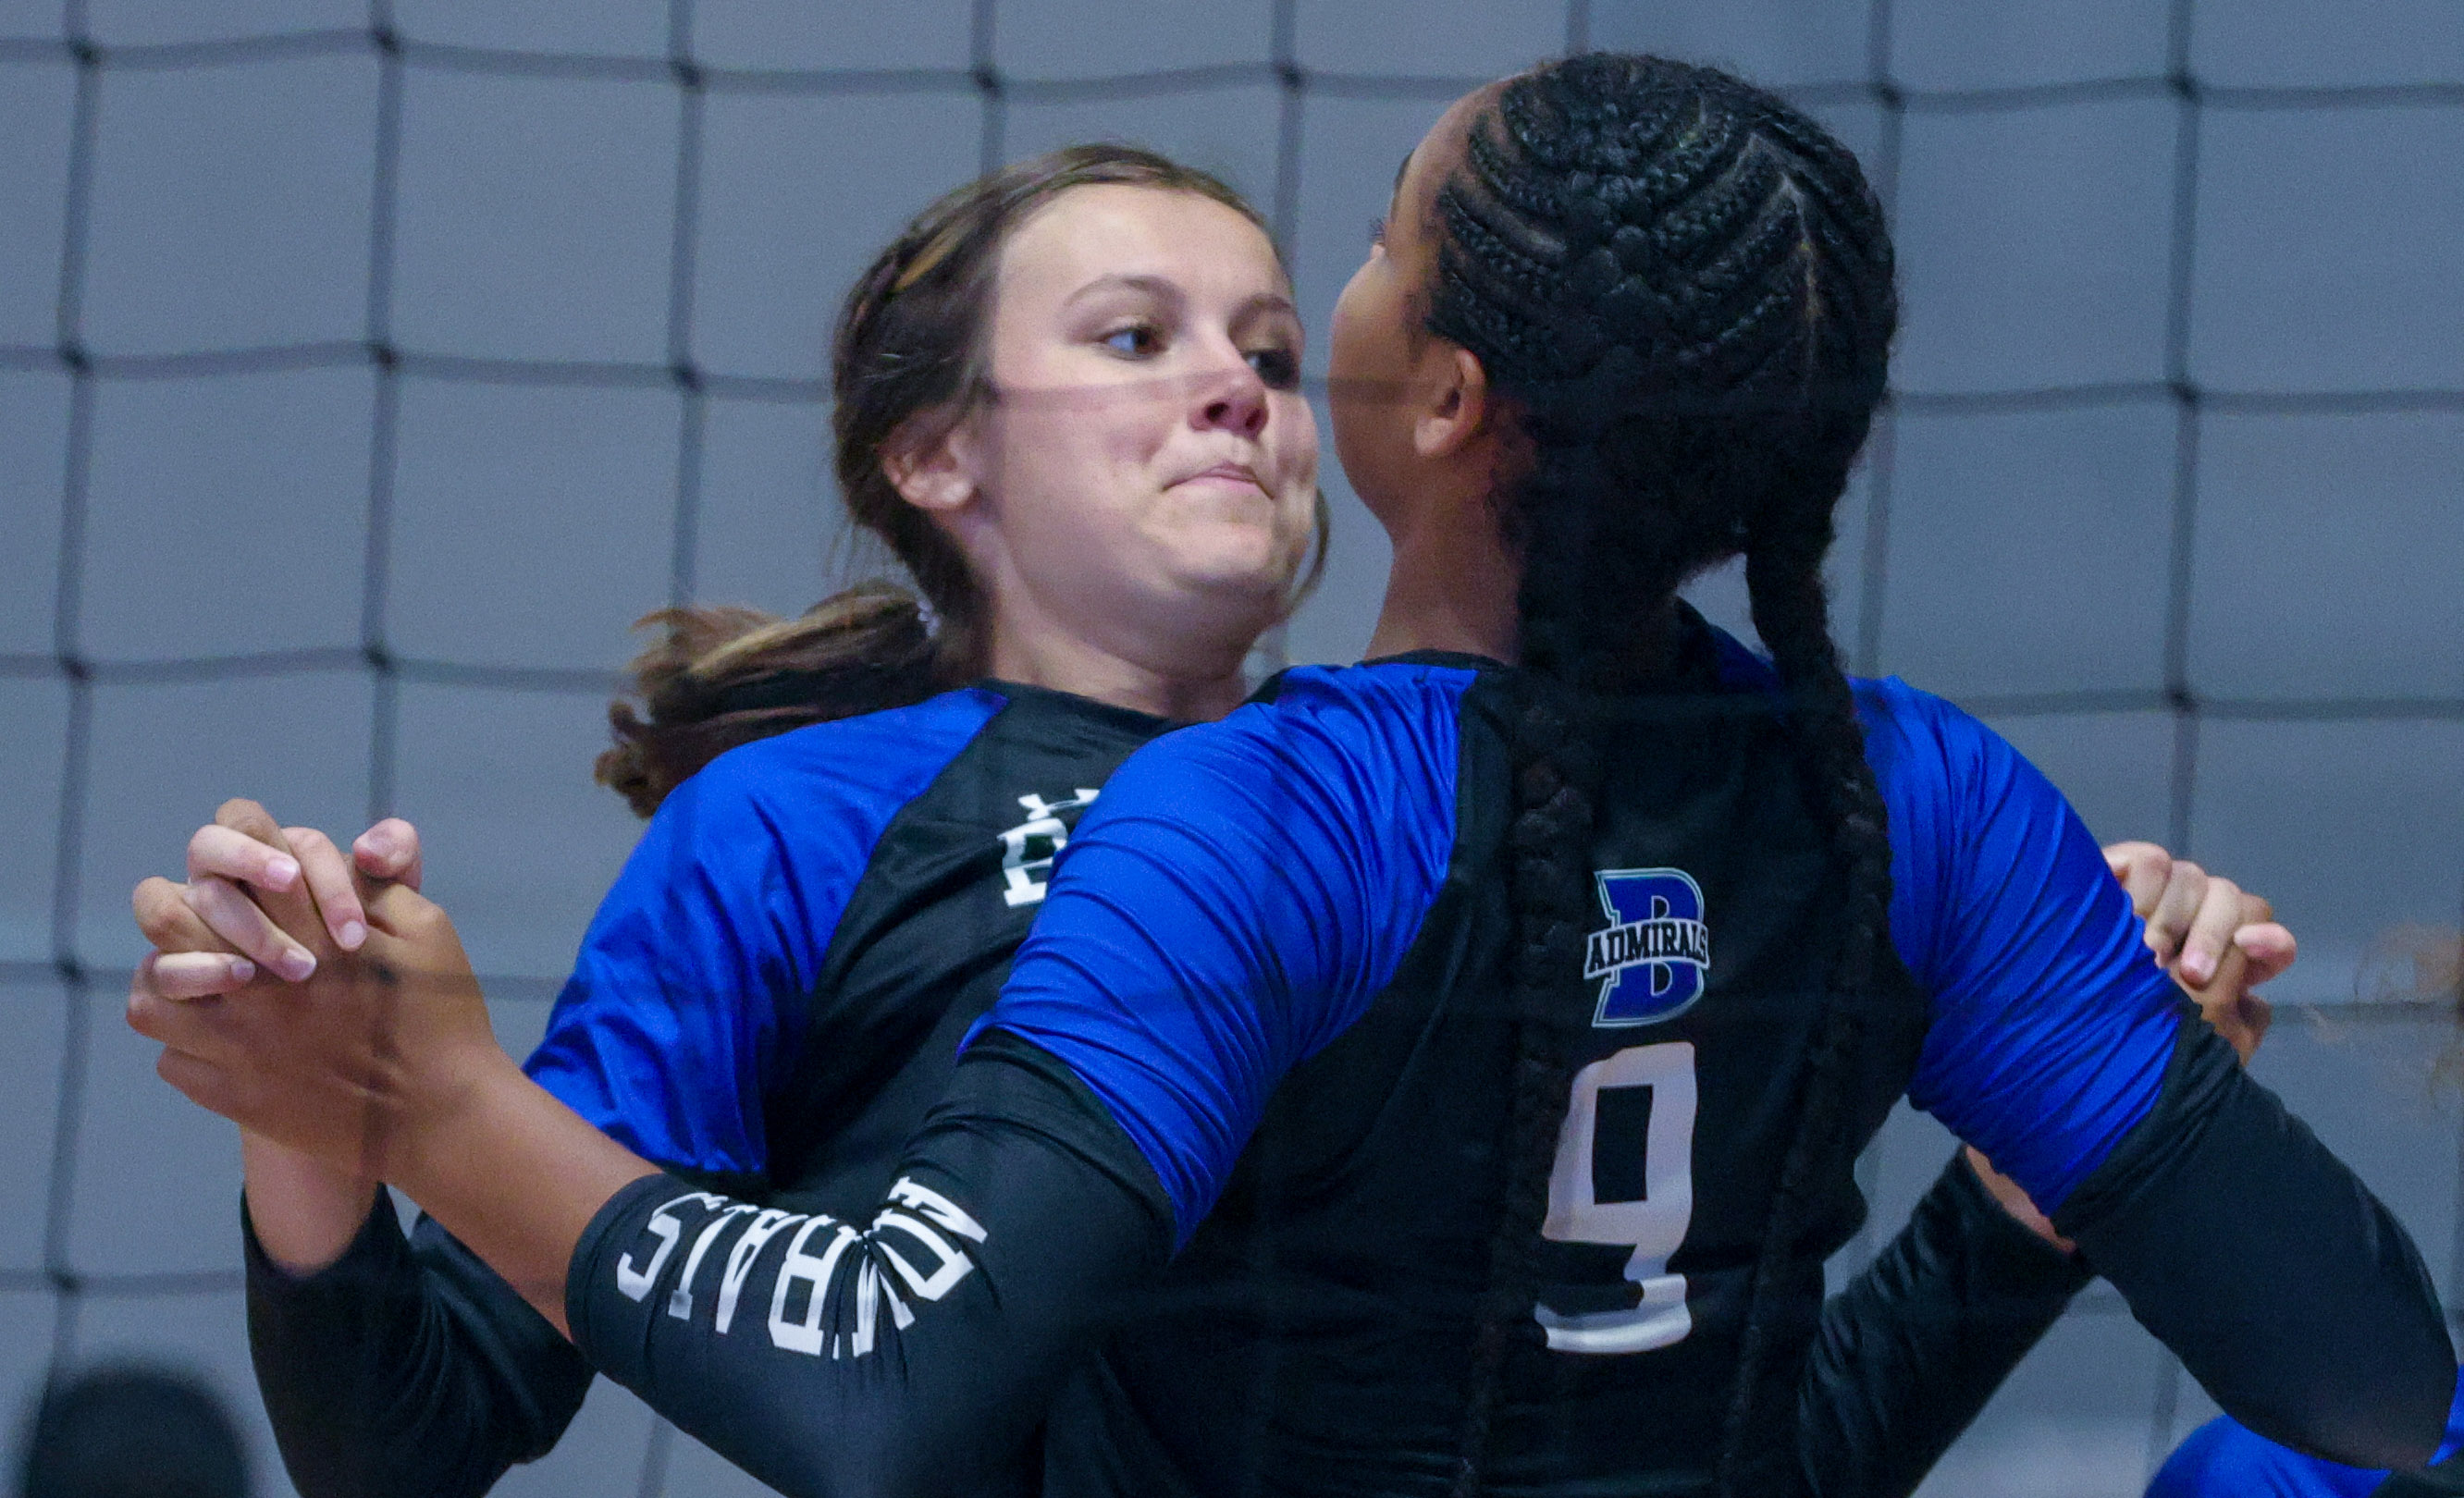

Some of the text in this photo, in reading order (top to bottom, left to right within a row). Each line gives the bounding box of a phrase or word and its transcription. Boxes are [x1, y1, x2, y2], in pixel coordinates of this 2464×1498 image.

[1587, 920, 1707, 973] ADMIRALS
[1592, 867, 1706, 1028] B
[617, 1176, 988, 1359] ADMRALS
[1534, 1040, 1698, 1355] 9
